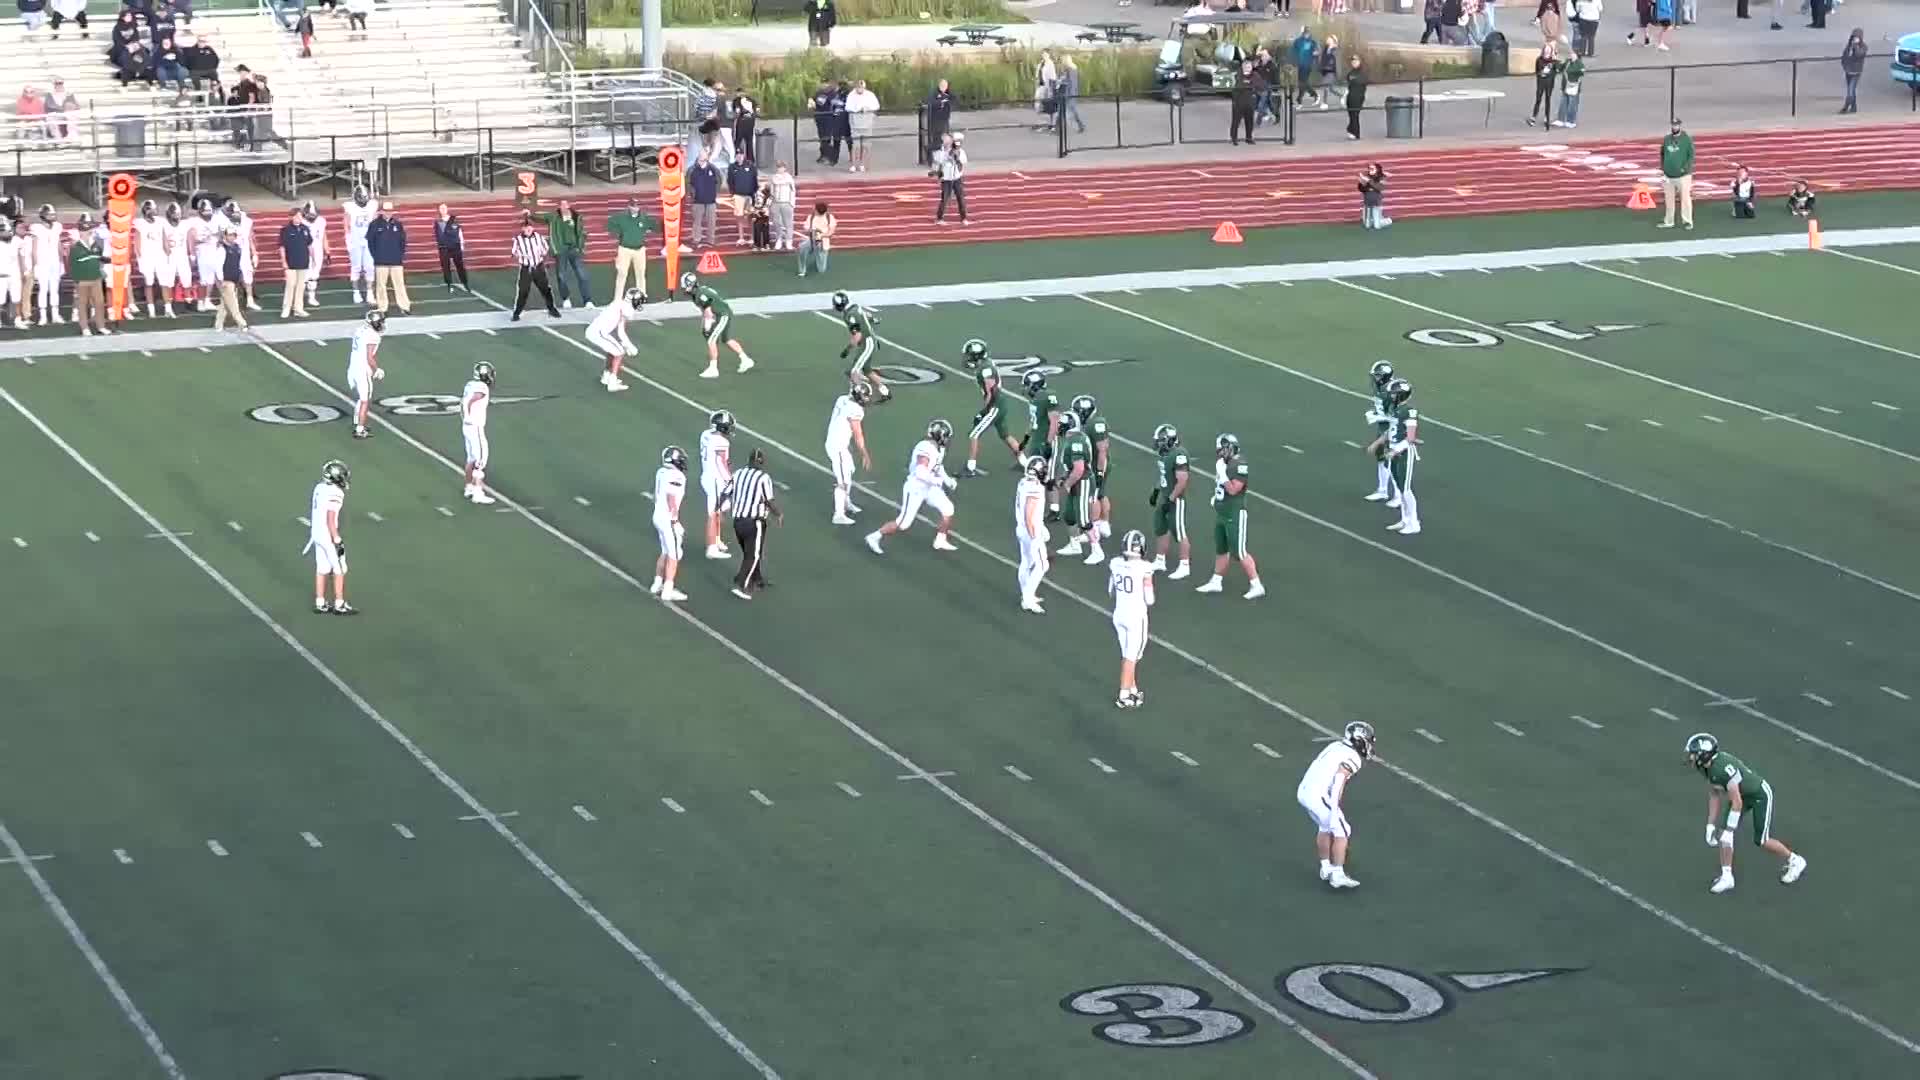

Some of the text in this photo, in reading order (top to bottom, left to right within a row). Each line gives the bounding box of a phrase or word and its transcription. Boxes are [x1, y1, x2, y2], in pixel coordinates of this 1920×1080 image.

[517, 172, 536, 194] 3
[1638, 191, 1650, 205] G
[1115, 573, 1134, 594] 20
